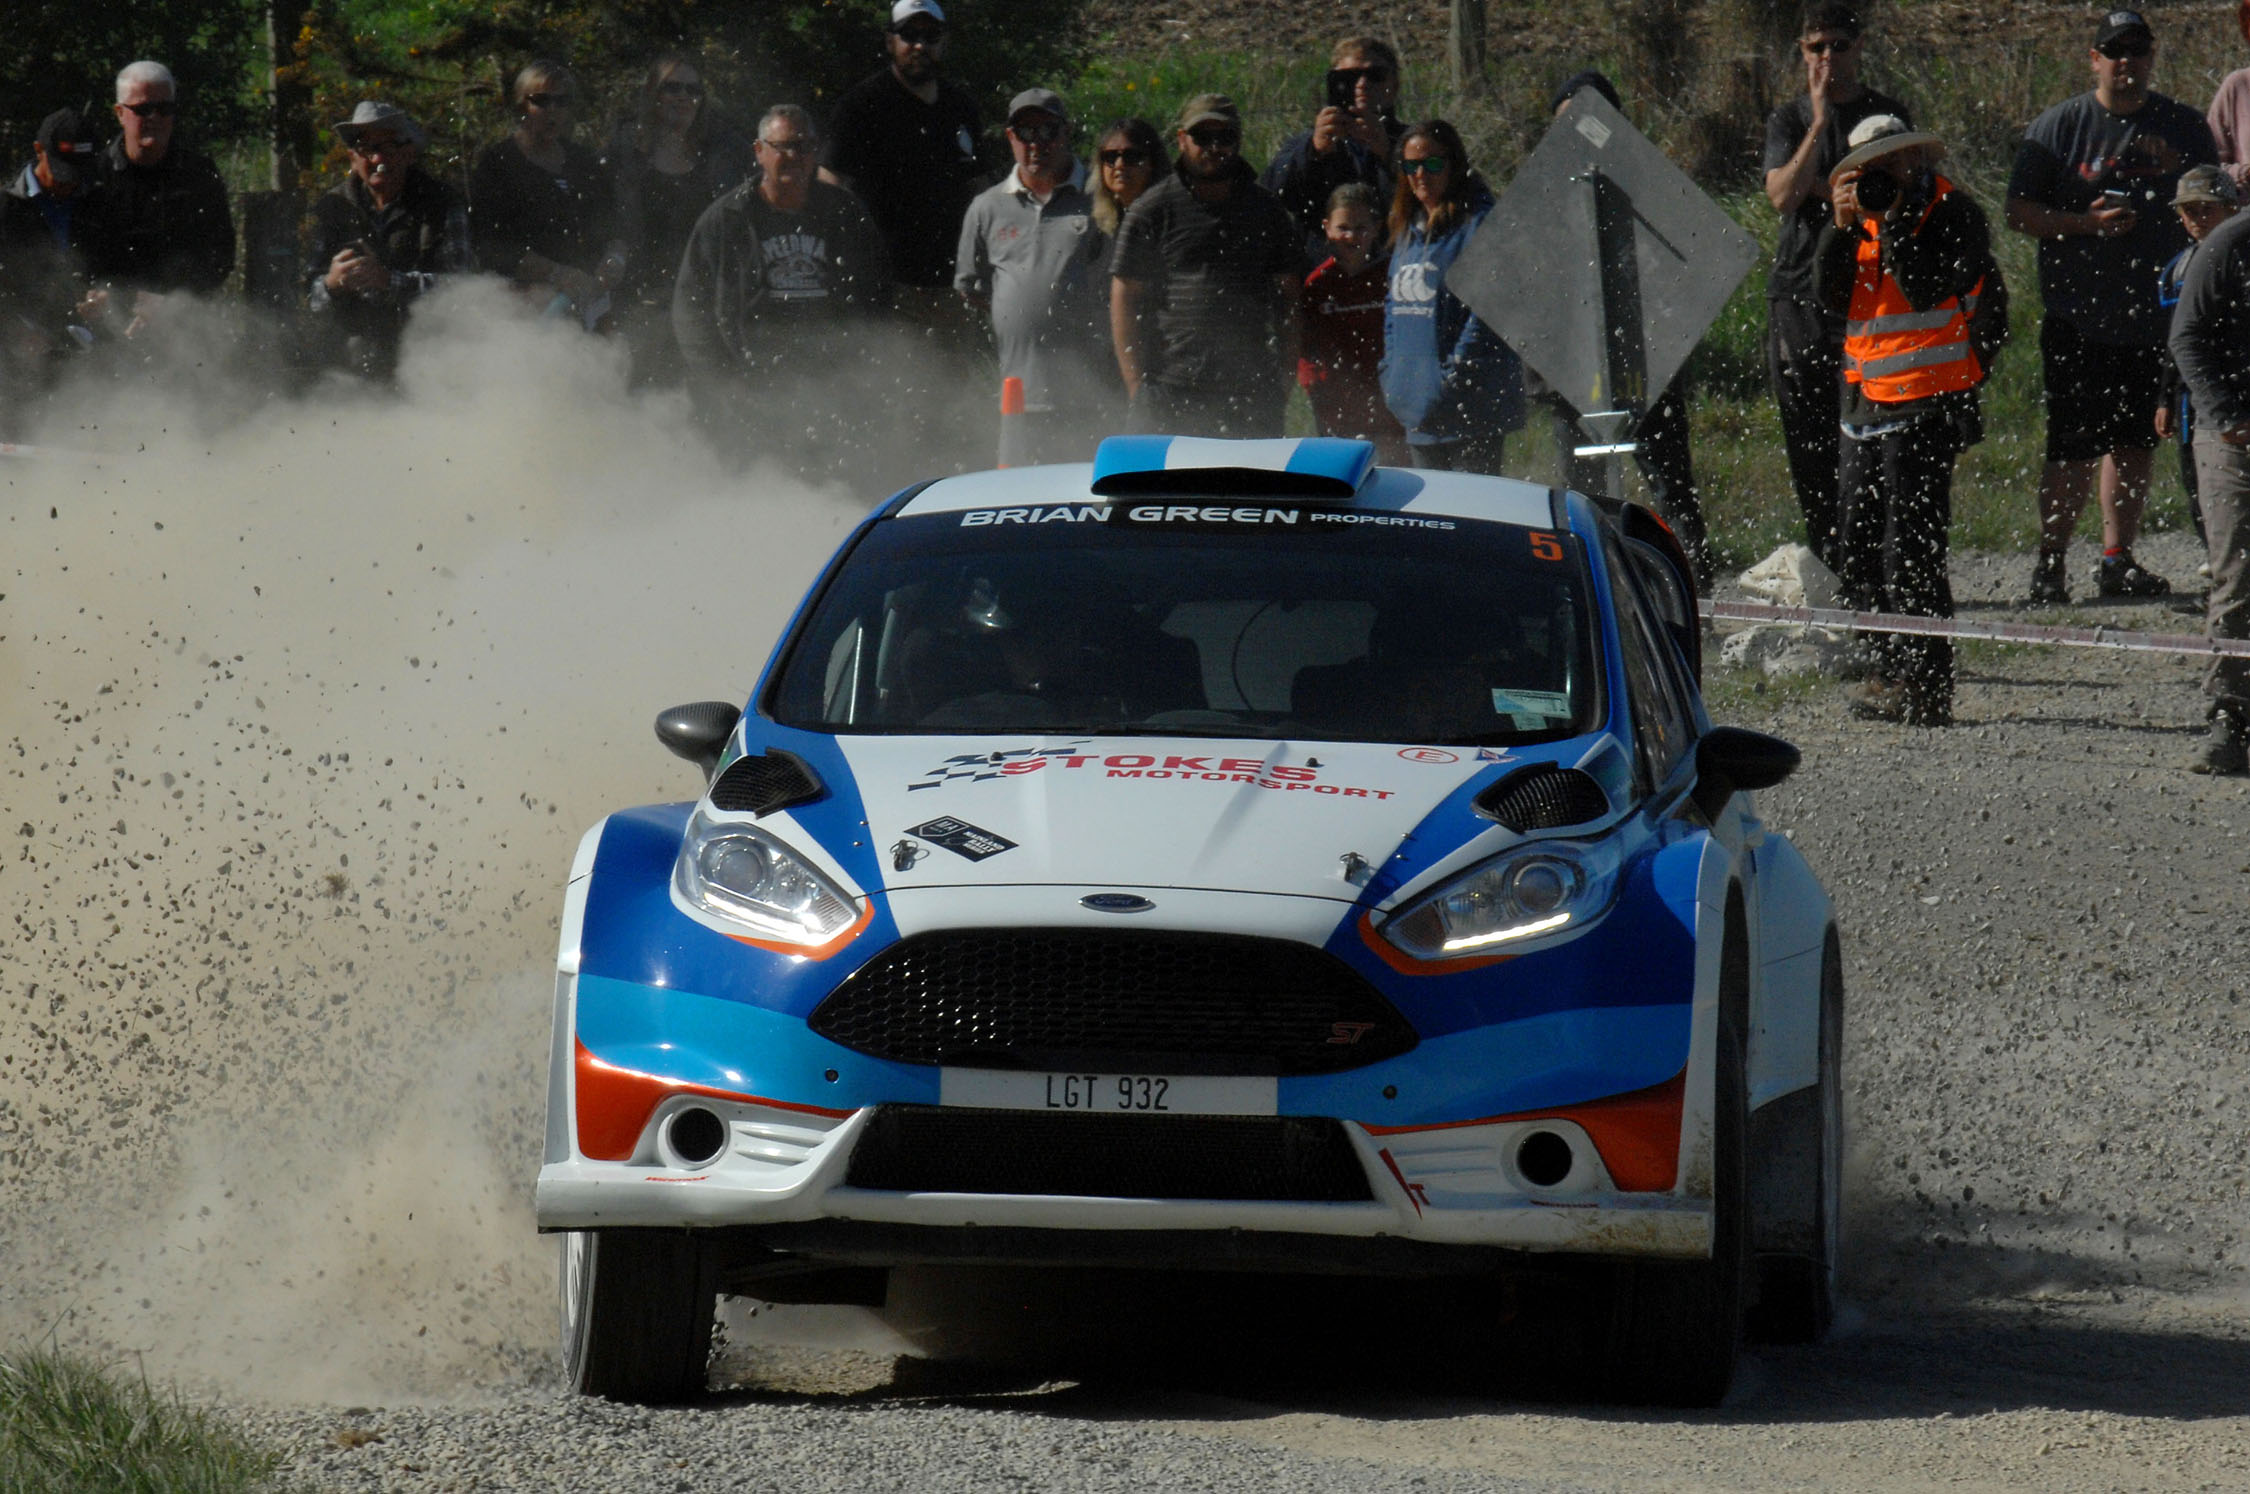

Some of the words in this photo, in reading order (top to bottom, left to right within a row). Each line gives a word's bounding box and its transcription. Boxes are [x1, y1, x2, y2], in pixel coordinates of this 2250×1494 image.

[960, 507, 1113, 527] BRIAN
[1129, 507, 1300, 524] GREEN
[1310, 513, 1456, 530] PROPERTIES
[1529, 532, 1564, 561] 5
[1000, 754, 1318, 782] STOKES
[1415, 750, 1444, 762] E
[1106, 769, 1396, 800] MOTORSPORT
[1326, 1022, 1376, 1045] ST
[1046, 1075, 1098, 1108] LGT
[1118, 1076, 1169, 1111] 932
